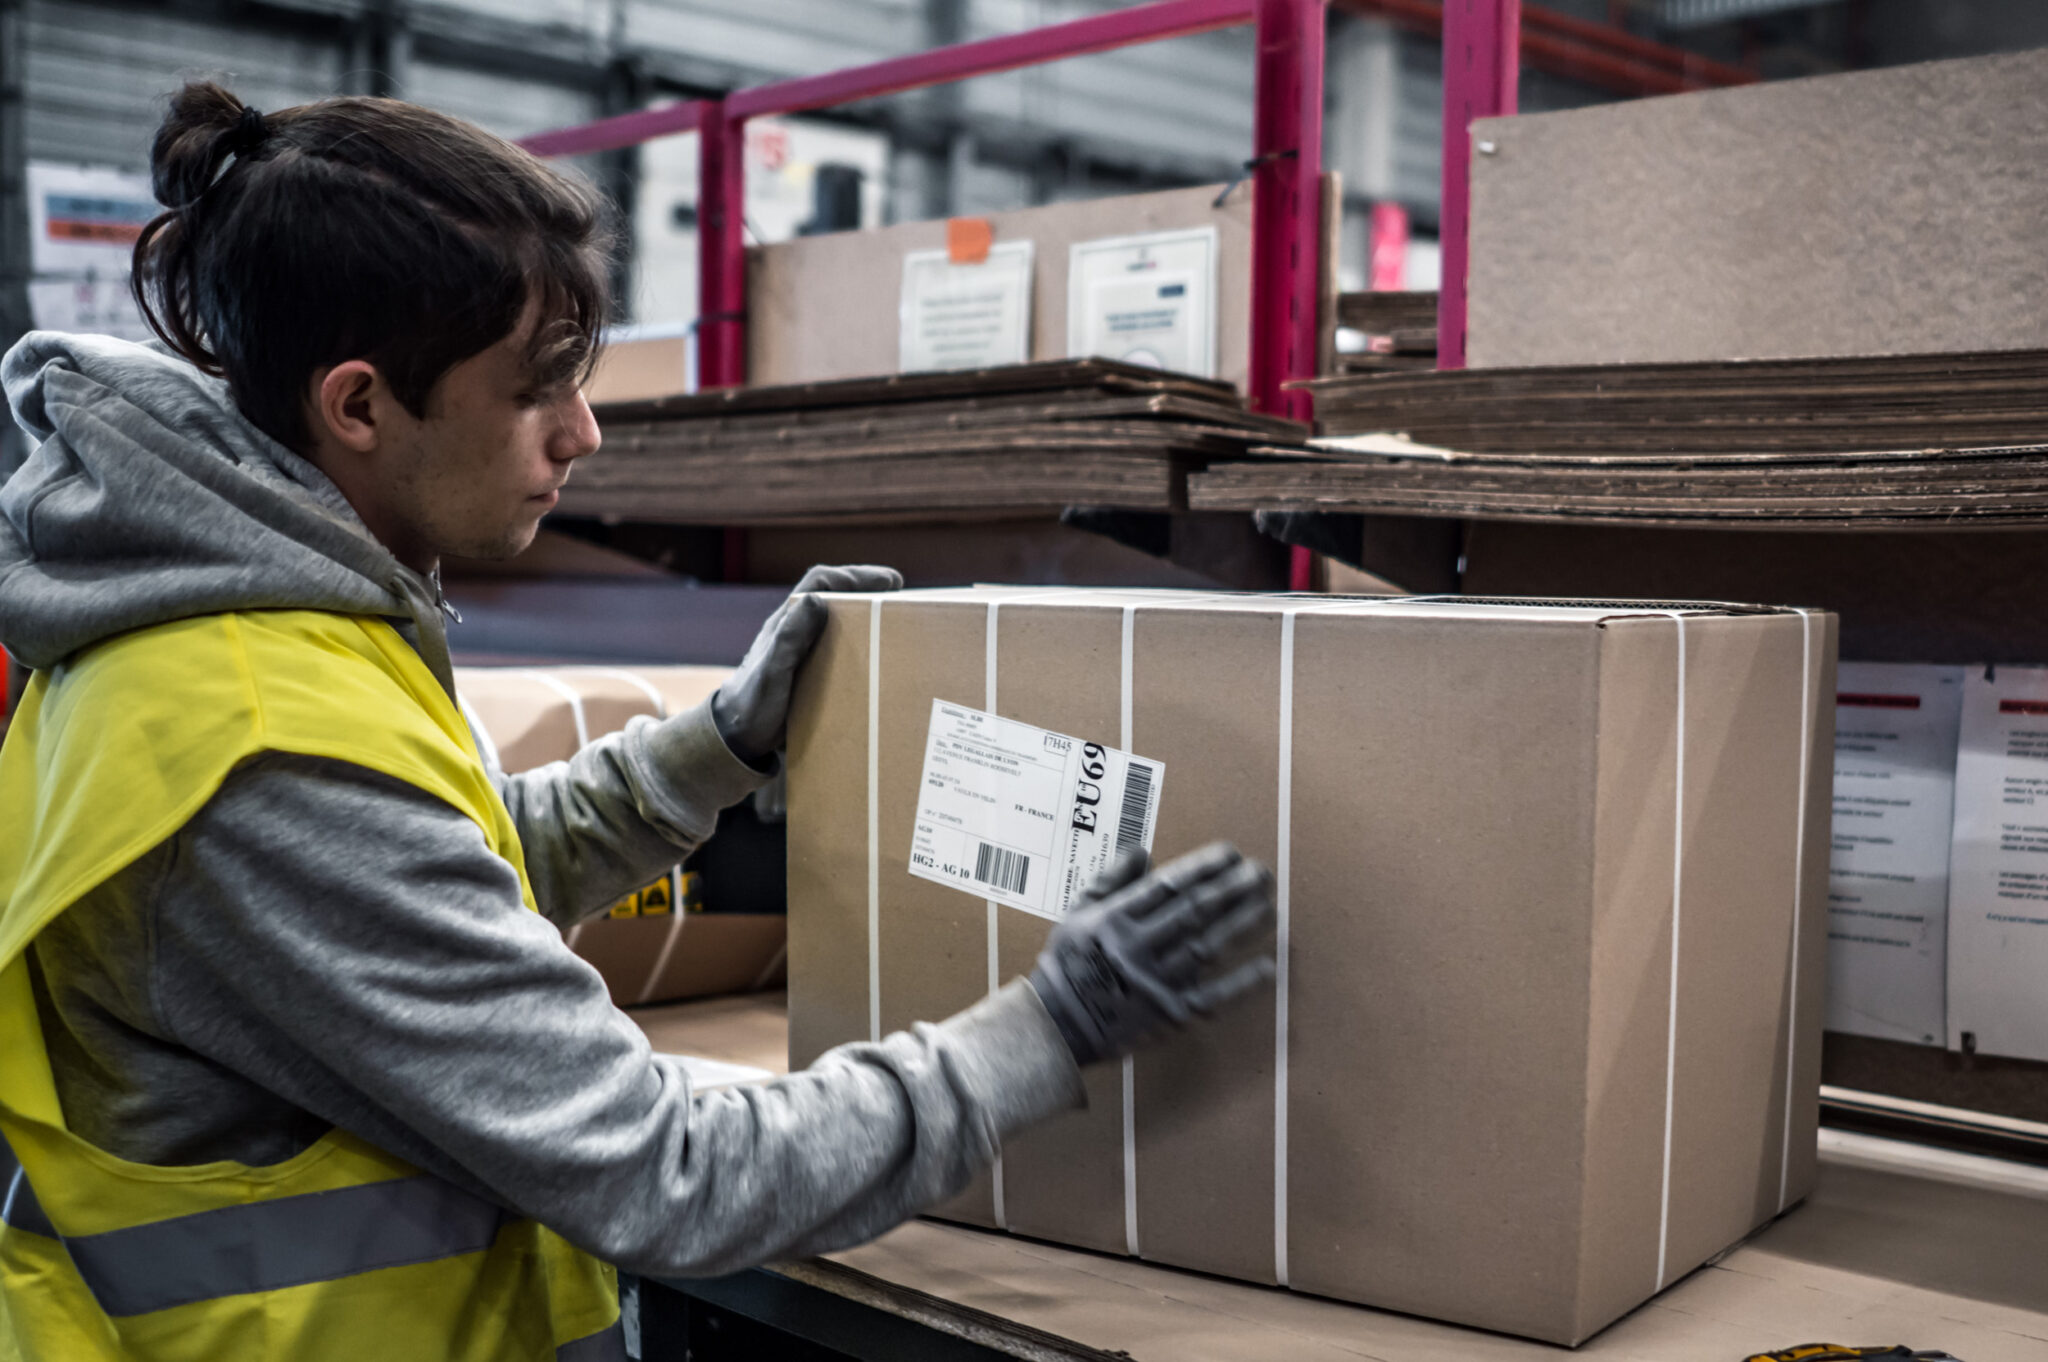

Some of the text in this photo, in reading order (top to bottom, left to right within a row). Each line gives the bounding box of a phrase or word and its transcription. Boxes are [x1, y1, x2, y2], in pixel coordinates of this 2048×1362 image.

[1071, 741, 1107, 836] EU69
[1028, 808, 1054, 821] FRANCE
[913, 853, 934, 868] HG2
[941, 863, 957, 876] AG
[959, 868, 970, 880] 10
